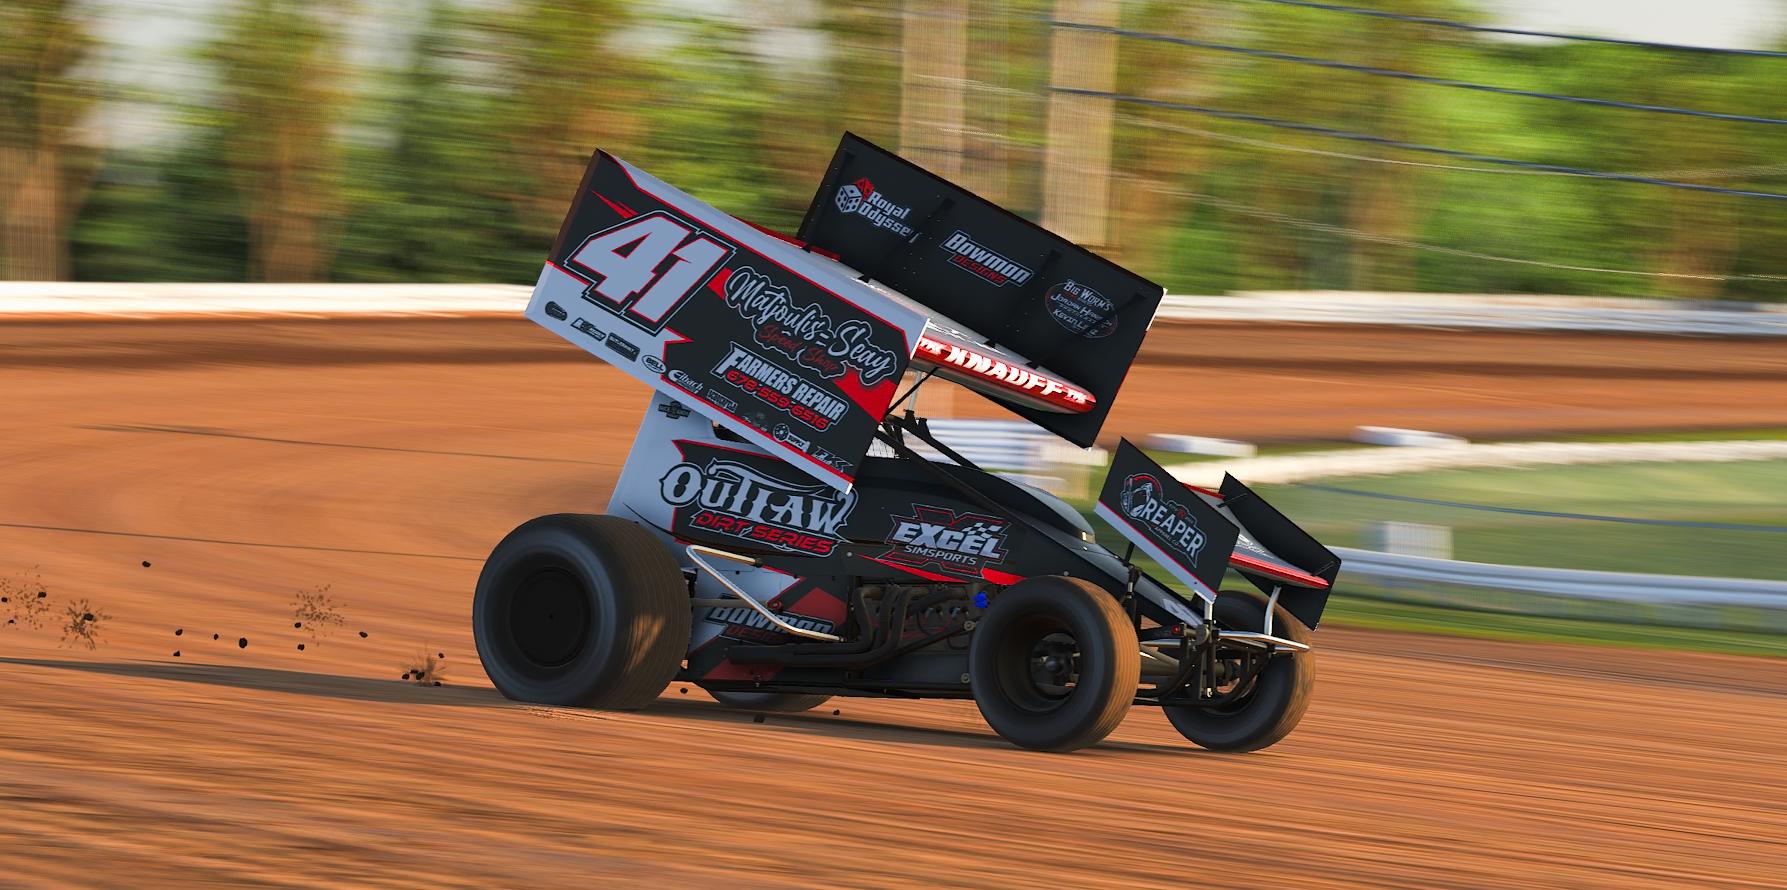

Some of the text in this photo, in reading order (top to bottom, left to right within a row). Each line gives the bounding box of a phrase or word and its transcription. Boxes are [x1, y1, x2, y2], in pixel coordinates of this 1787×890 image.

[867, 191, 911, 220] Royal
[572, 216, 728, 323] 41
[645, 357, 664, 371] BELL
[758, 324, 839, 373] Speed Shop
[668, 369, 704, 392] Eibach
[716, 349, 846, 421] FARMERS REPAIR
[696, 513, 834, 553] DIRT SERIES
[892, 521, 1001, 558] EXCEL
[1140, 497, 1203, 557] REAPER
[904, 545, 978, 566] SIMSPORTS
